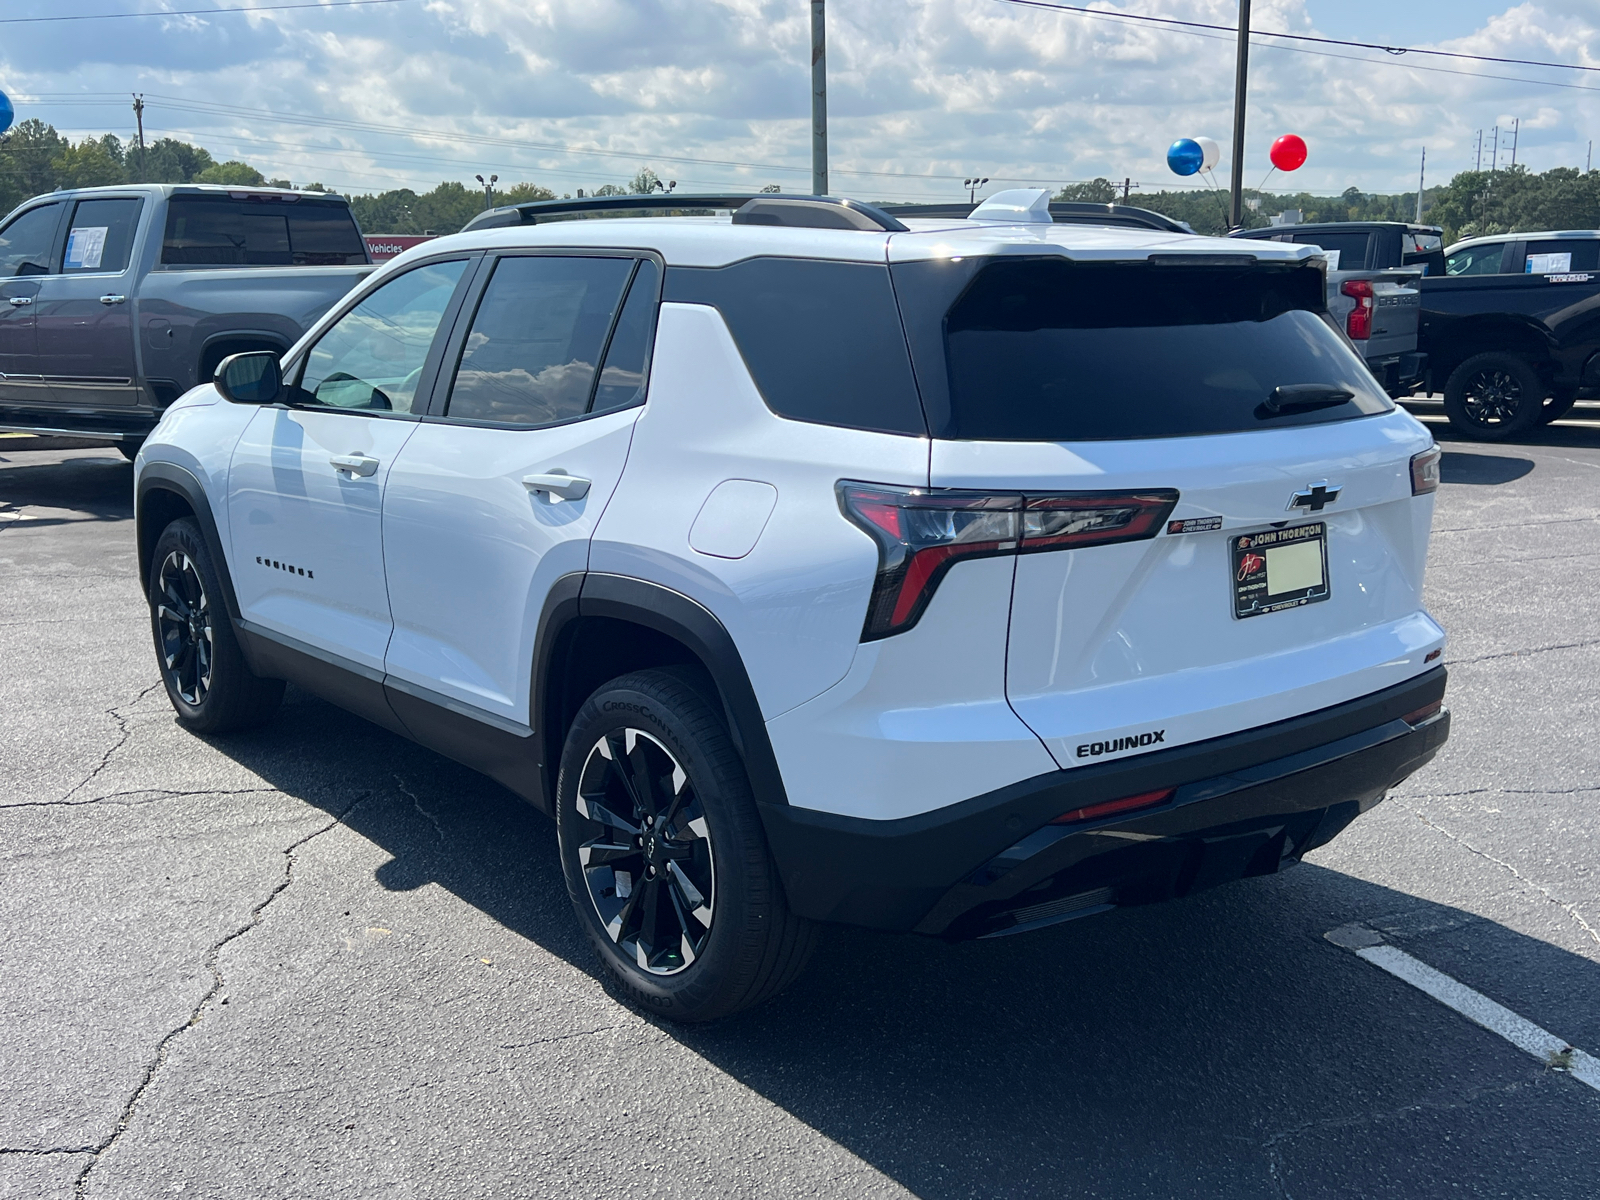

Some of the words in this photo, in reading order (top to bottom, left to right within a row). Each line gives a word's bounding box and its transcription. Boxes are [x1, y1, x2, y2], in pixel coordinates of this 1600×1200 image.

[368, 243, 403, 254] Vehicles
[1254, 532, 1277, 545] JOHN
[1278, 524, 1321, 540] THORNTON
[255, 556, 314, 579] EQUINOX
[1271, 600, 1299, 611] CHEVROLET
[1076, 729, 1165, 758] EQUINOX
